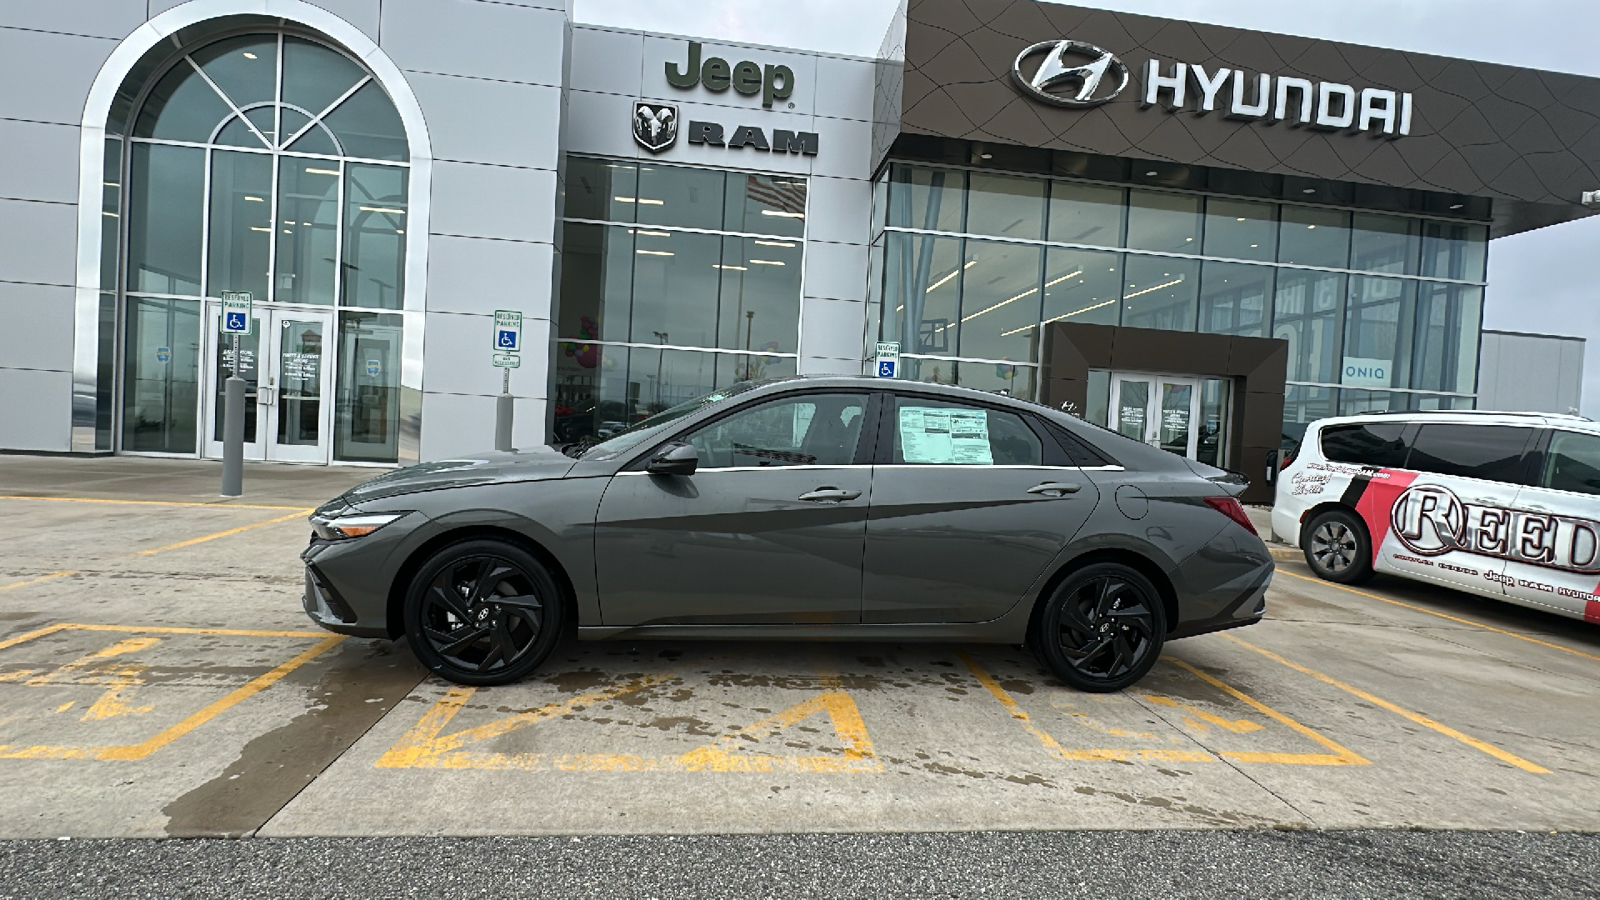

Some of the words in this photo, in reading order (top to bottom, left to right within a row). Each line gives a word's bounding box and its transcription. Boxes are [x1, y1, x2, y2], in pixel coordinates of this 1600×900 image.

[665, 42, 794, 108] Jeep
[1140, 58, 1413, 137] HYUNDAI
[688, 120, 819, 157] RAM
[1390, 484, 1600, 574] REED
[1484, 569, 1515, 587] Jeep
[1518, 579, 1553, 593] RAM
